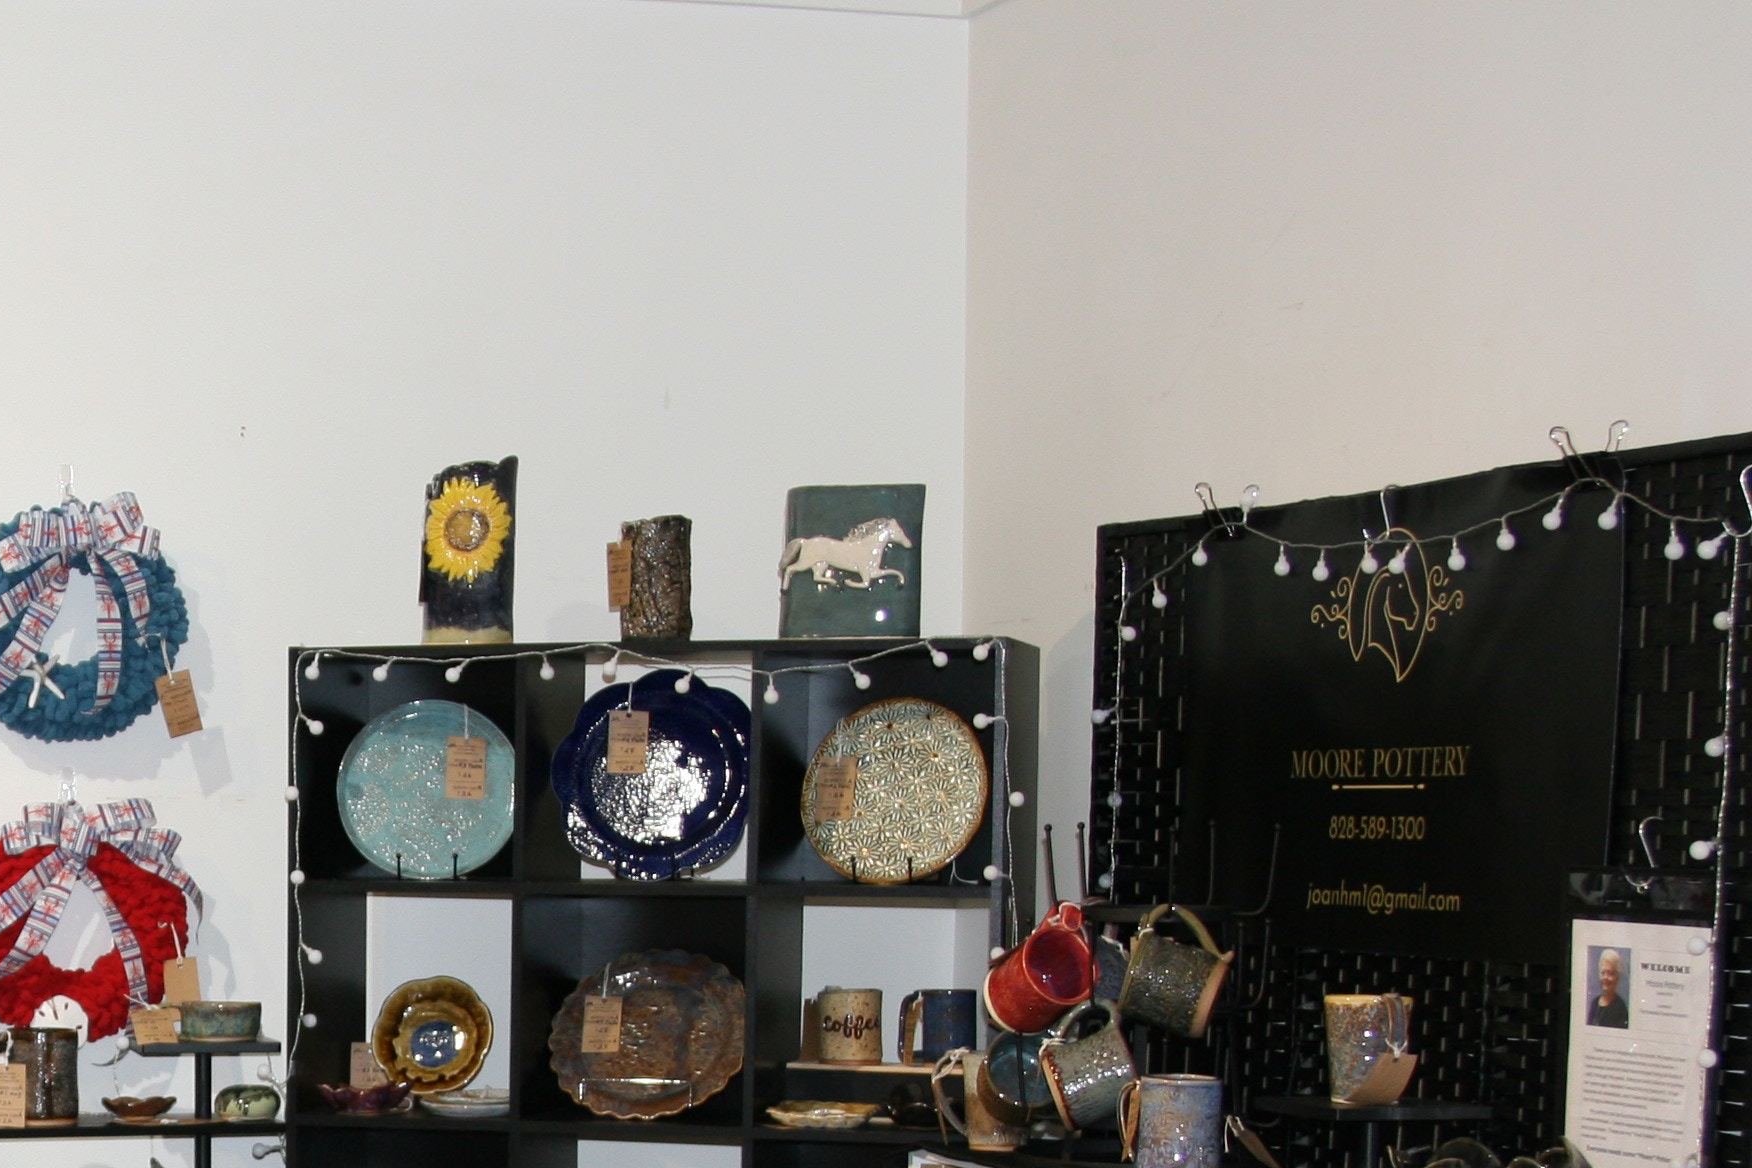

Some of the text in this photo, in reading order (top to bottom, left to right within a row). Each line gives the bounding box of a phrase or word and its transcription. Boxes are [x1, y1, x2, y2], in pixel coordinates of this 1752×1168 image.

[1292, 745, 1470, 778] MOORE POTTERY
[1328, 815, 1425, 840] 828-589-1300
[1640, 962, 1691, 974] WELCOME
